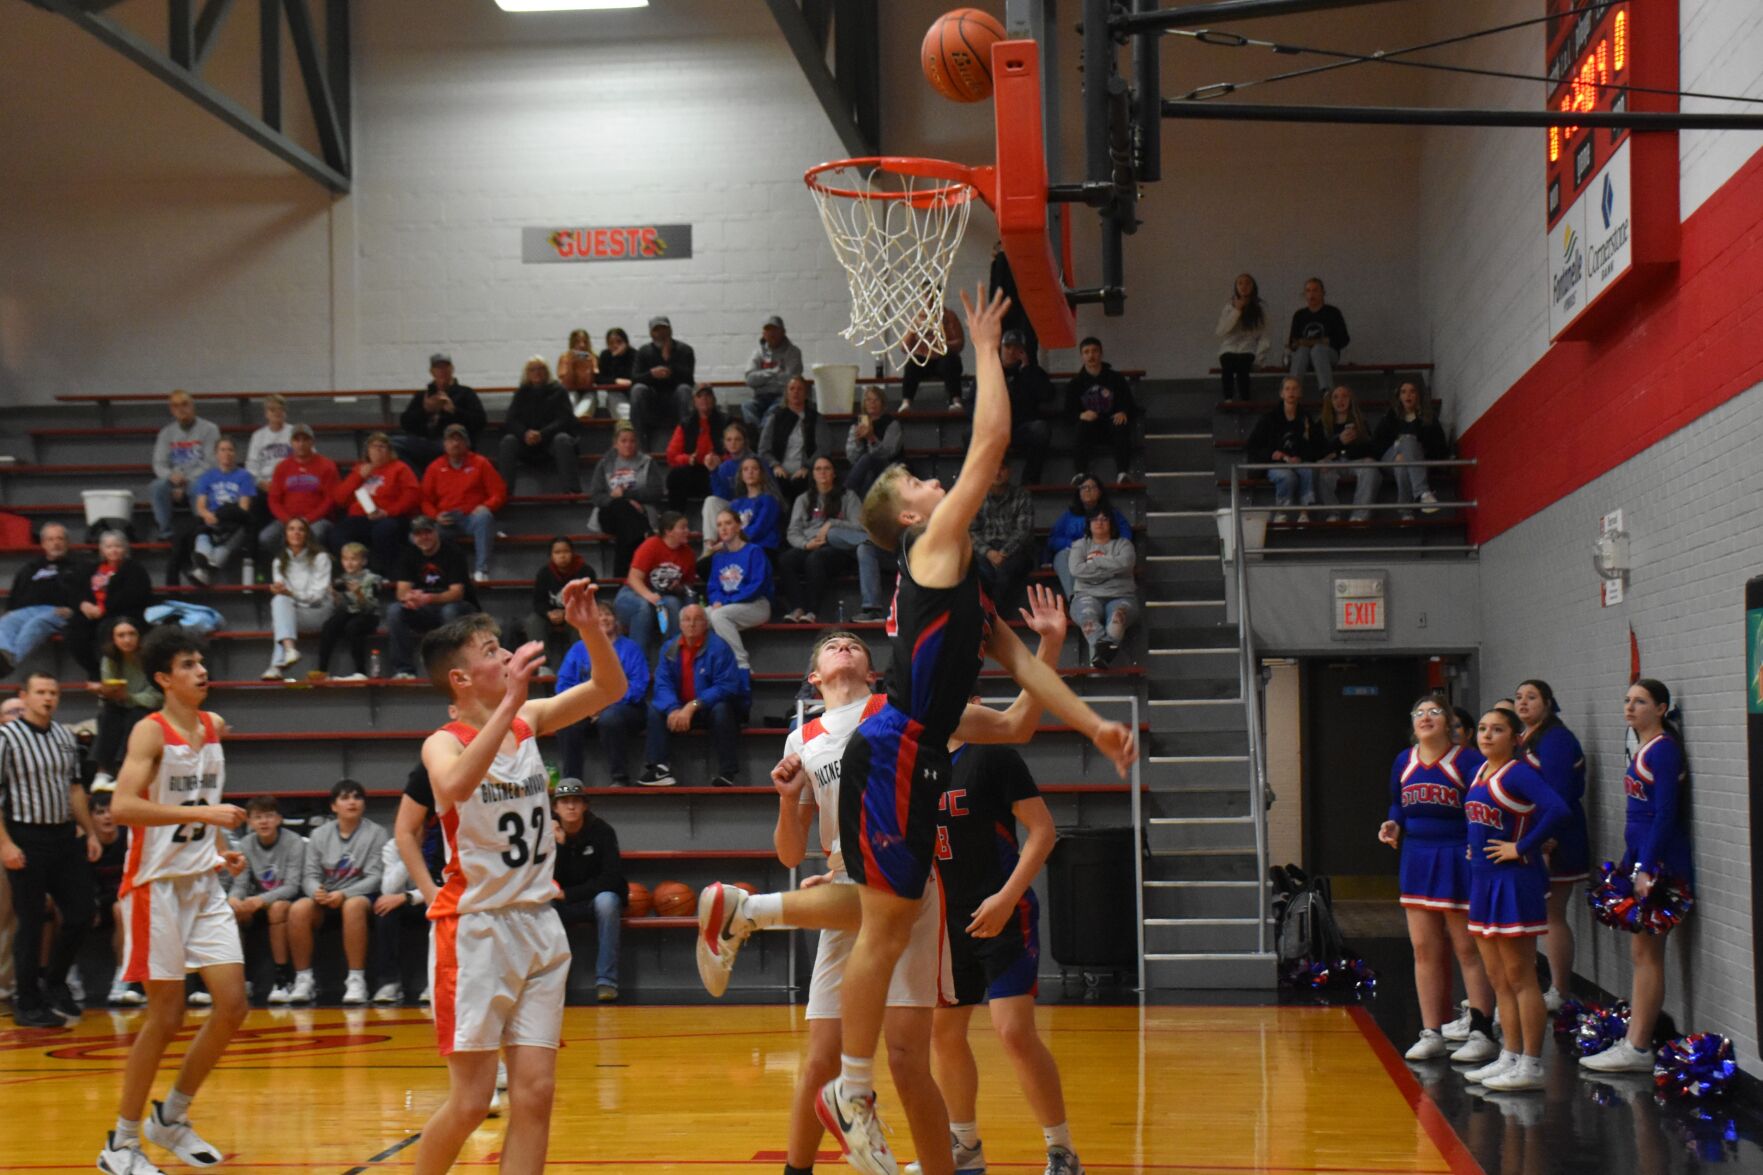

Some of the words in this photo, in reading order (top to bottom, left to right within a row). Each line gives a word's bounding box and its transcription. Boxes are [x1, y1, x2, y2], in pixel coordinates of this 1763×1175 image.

[556, 228, 658, 258] GUESTS
[1344, 602, 1377, 626] EXIT
[1401, 782, 1461, 808] STORM
[498, 806, 548, 869] 32
